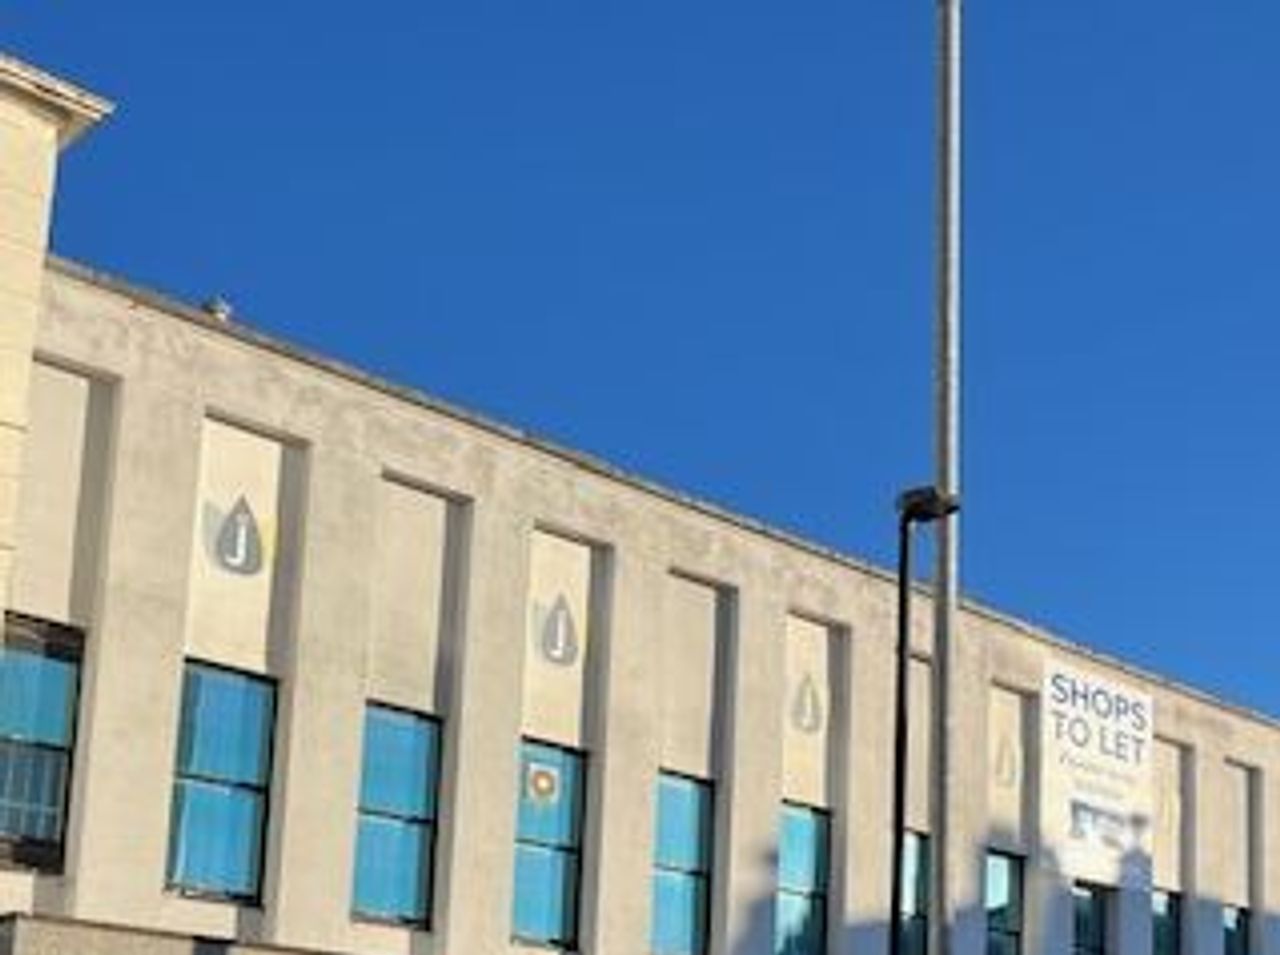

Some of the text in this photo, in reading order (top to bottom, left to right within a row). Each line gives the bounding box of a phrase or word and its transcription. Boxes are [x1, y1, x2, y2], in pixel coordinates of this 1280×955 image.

[1051, 674, 1147, 731] SHOPS
[1051, 710, 1146, 765] TO LET
